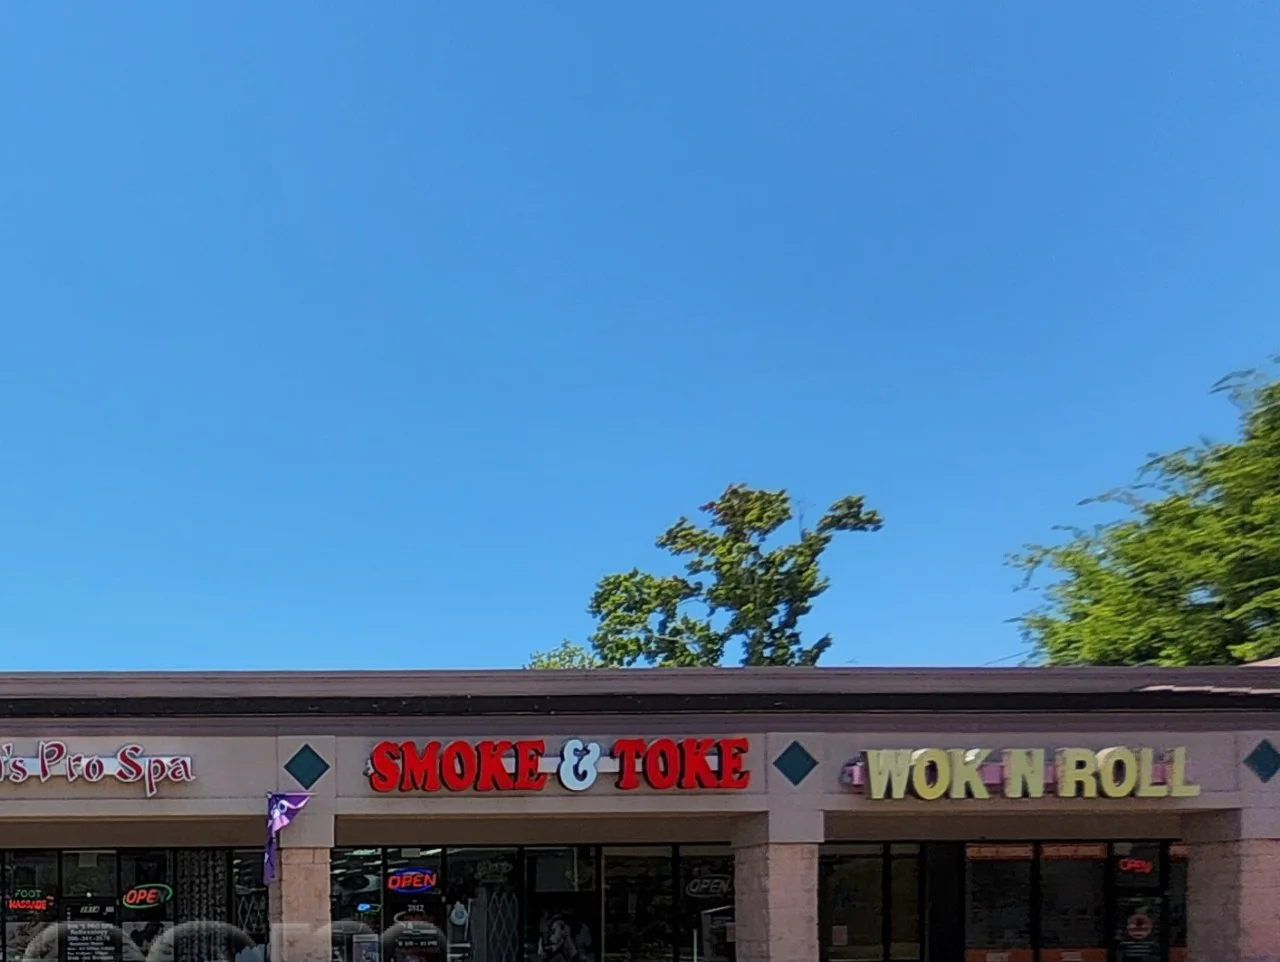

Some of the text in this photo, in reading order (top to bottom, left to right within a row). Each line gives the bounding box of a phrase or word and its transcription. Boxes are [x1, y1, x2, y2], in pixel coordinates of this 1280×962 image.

[37, 740, 105, 783] Pro
[116, 743, 195, 797] Spa
[370, 737, 751, 792] SMOKE & TOKE
[865, 745, 1202, 801] WOK N ROLL
[14, 889, 42, 898] FOOT
[387, 873, 438, 890] OPEN
[689, 878, 730, 893] OPEN
